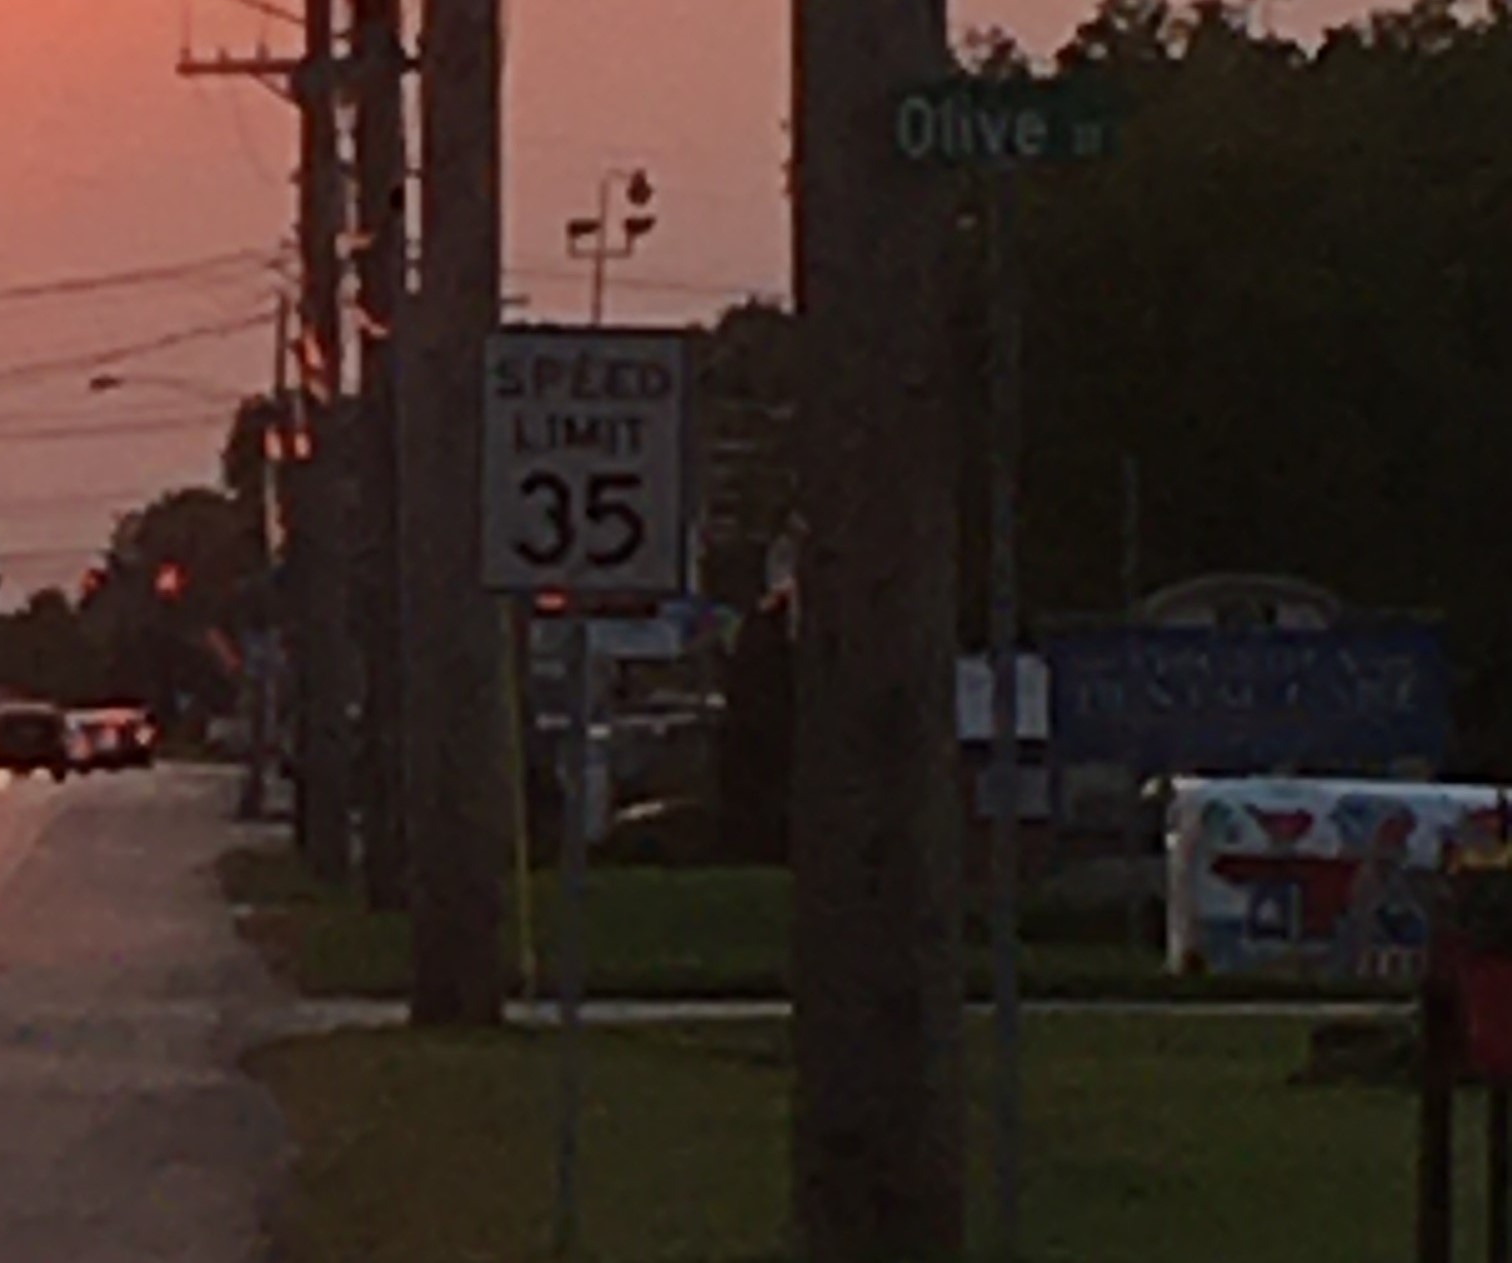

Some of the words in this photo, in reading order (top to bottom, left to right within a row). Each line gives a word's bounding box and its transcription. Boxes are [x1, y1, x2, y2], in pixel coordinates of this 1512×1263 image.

[896, 95, 1049, 160] Olive
[495, 356, 672, 400] SPEED
[513, 414, 644, 454] LIMIT
[514, 472, 644, 567] 35
